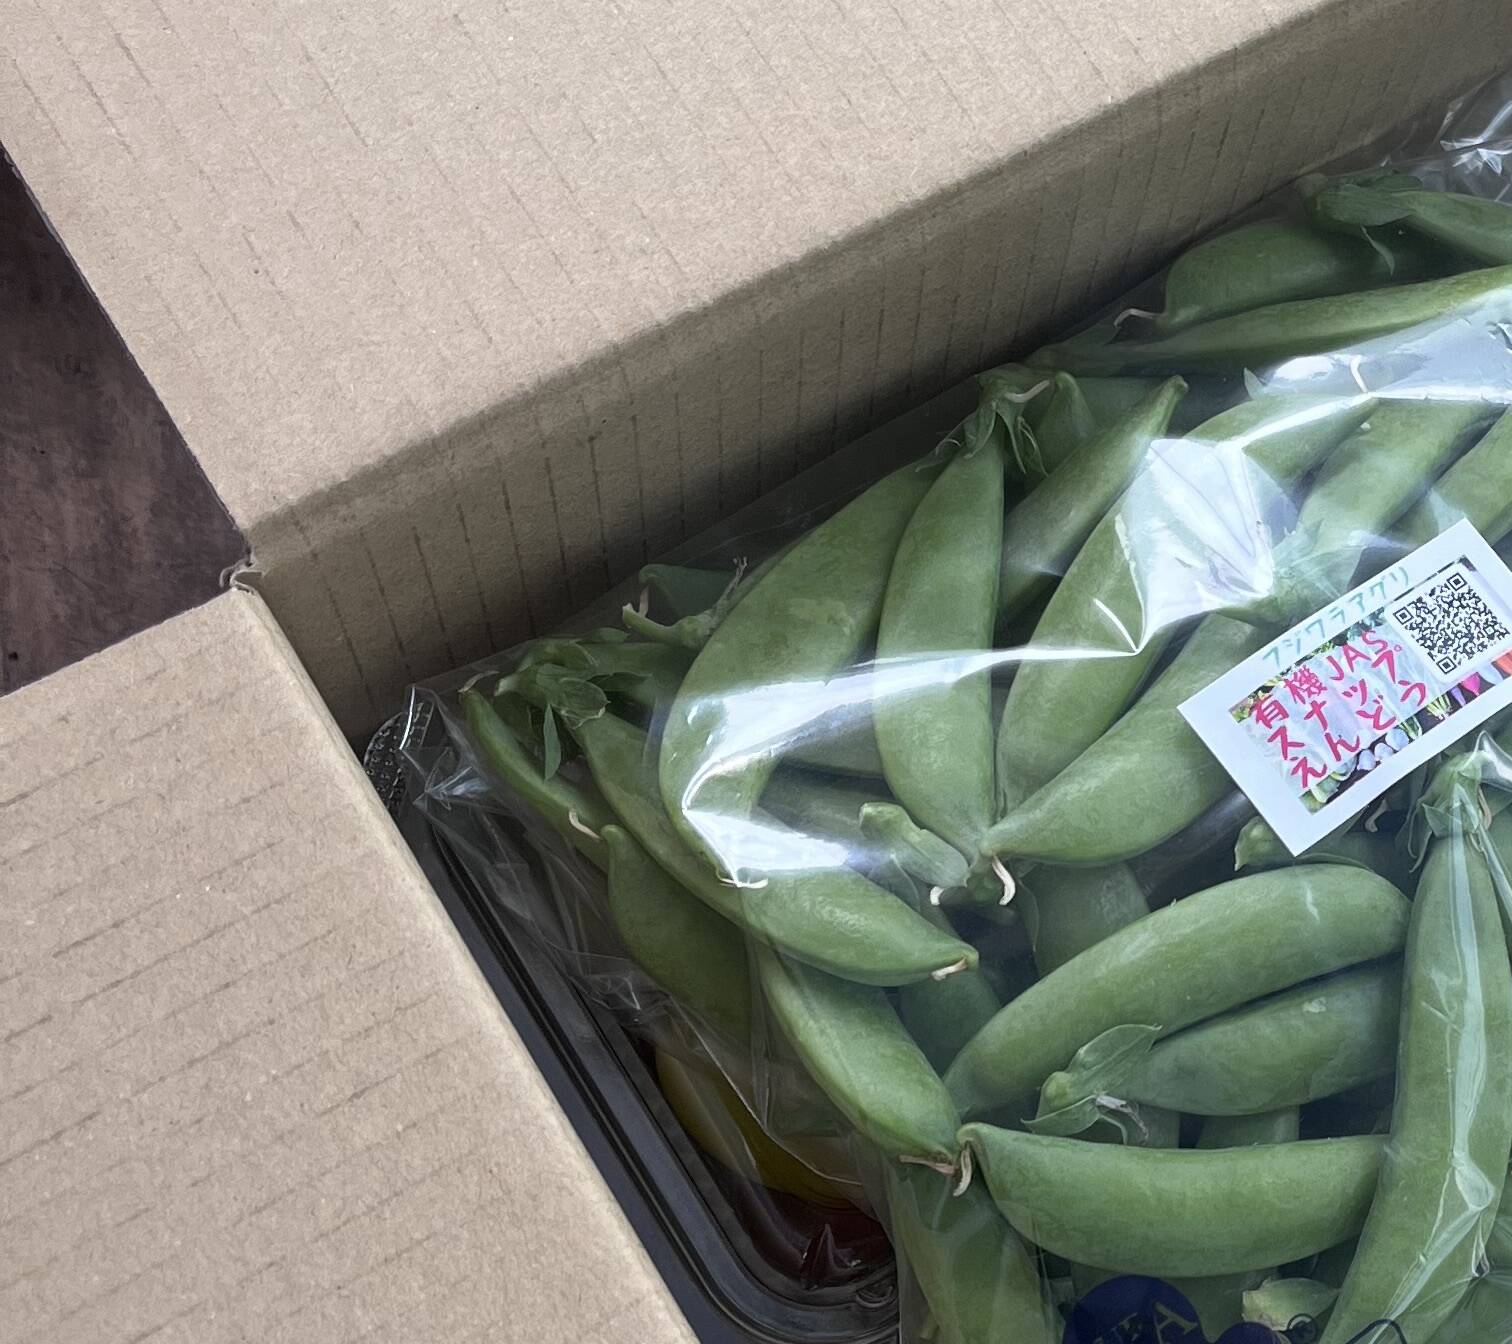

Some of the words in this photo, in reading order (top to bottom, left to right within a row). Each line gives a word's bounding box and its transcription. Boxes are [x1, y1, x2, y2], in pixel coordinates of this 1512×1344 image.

[1262, 566, 1410, 668] フジワラアグリ
[1254, 630, 1392, 729] 有機JAS
[1266, 643, 1404, 760] スナップ
[1290, 676, 1427, 788] えんどう
